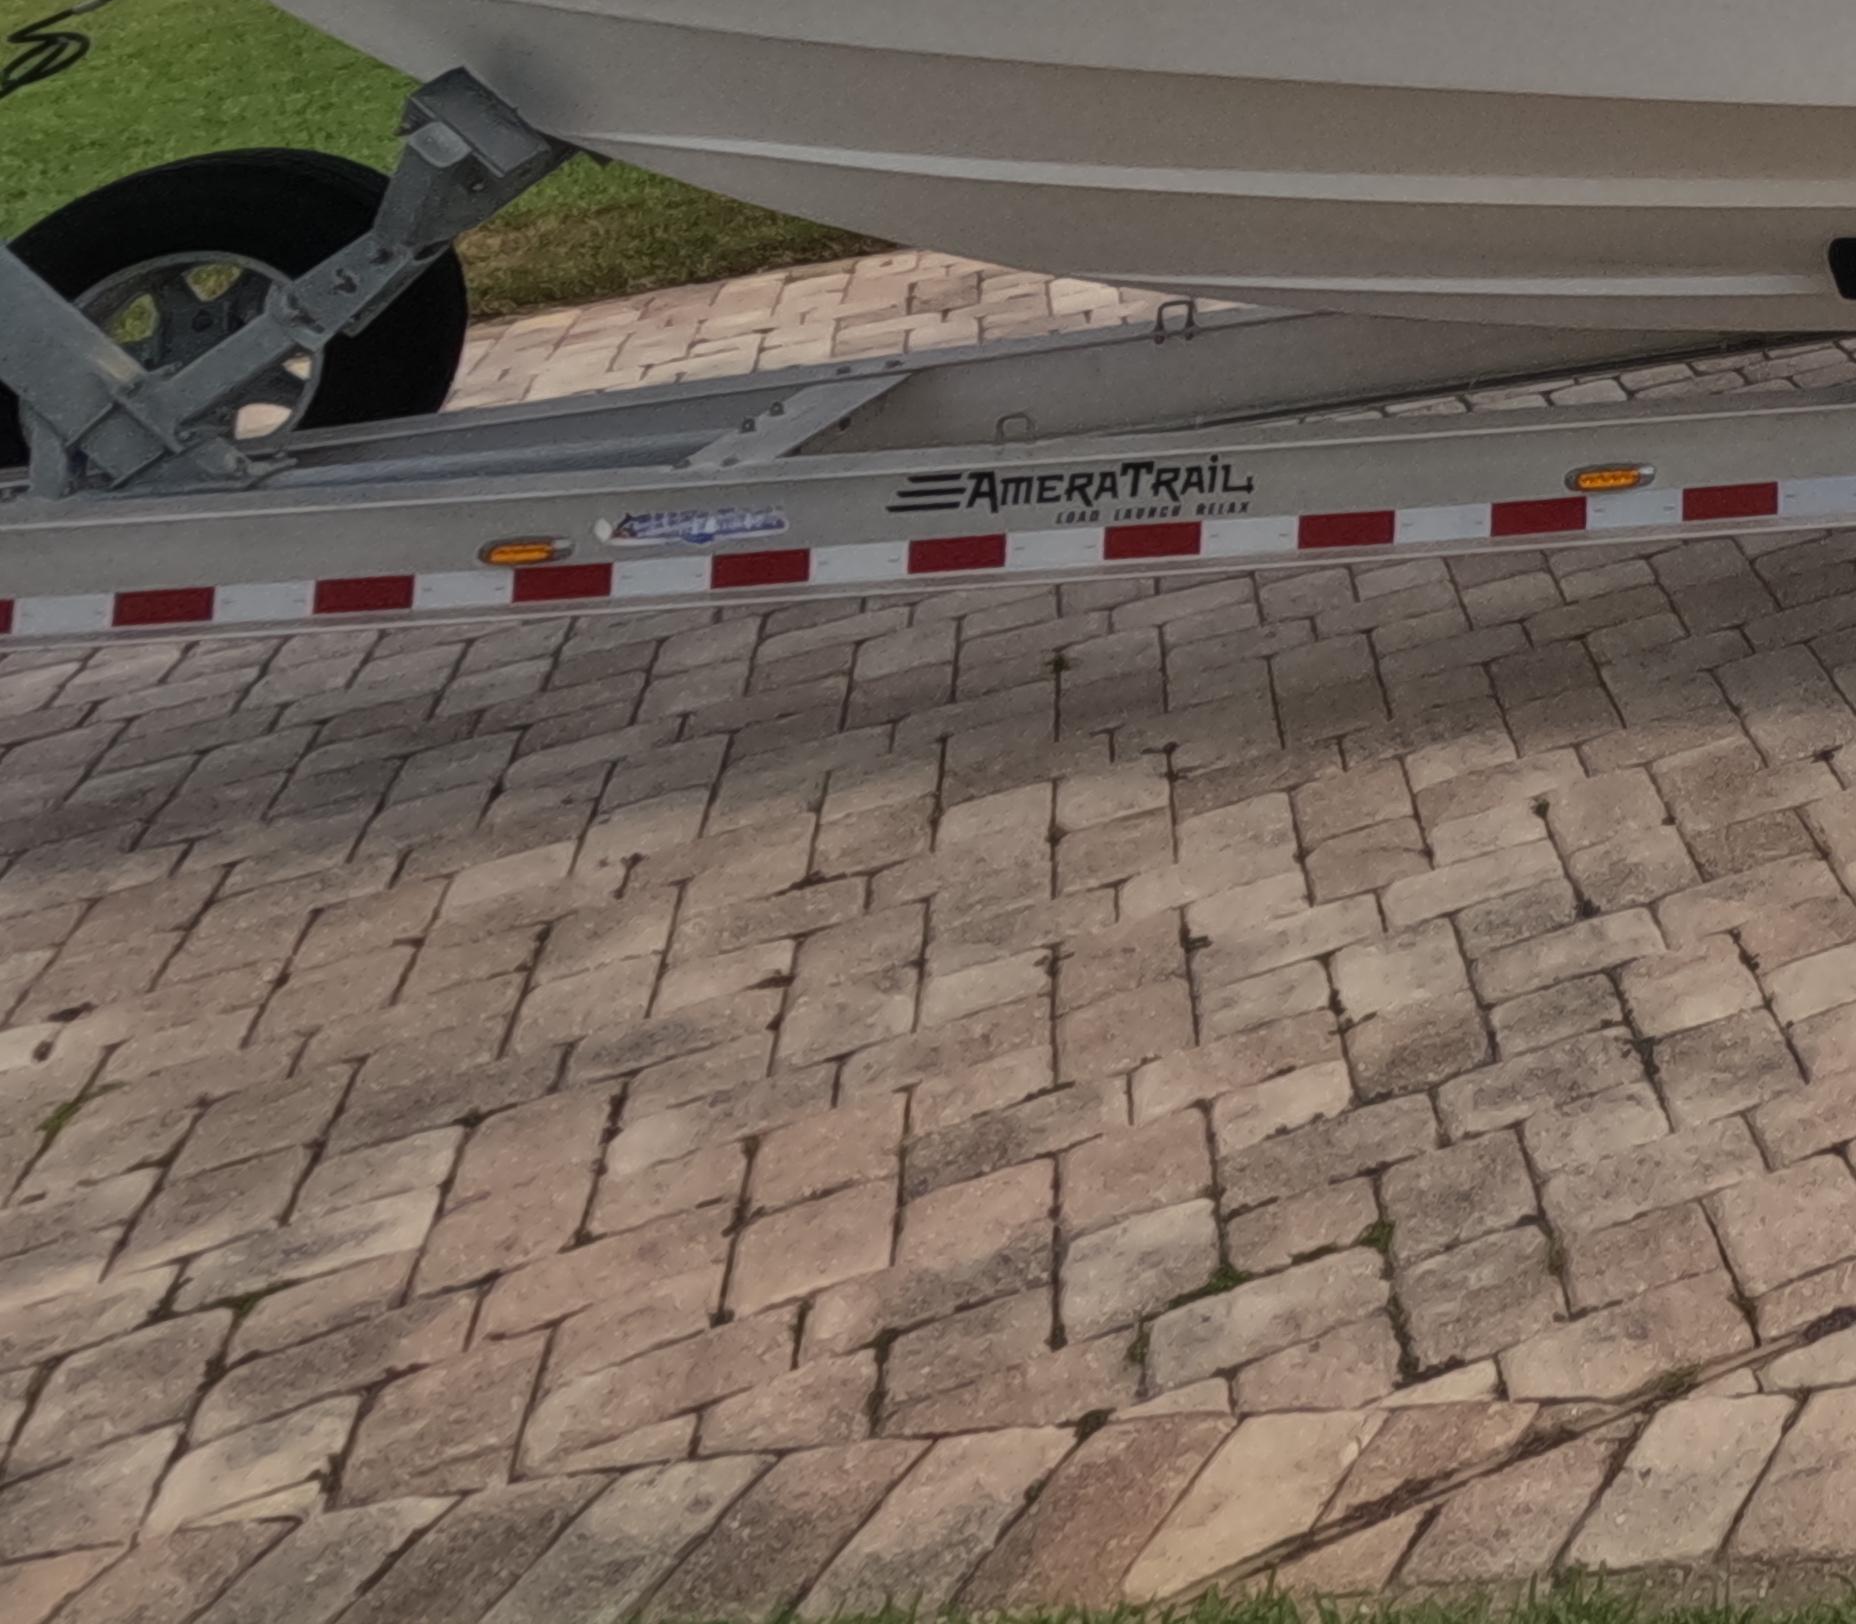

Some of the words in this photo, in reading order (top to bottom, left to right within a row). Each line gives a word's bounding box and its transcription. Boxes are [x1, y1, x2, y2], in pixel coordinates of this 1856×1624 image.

[1055, 510, 1100, 524] LOAD
[1113, 505, 1183, 521] LAUNCH
[1195, 501, 1250, 516] RELAX
